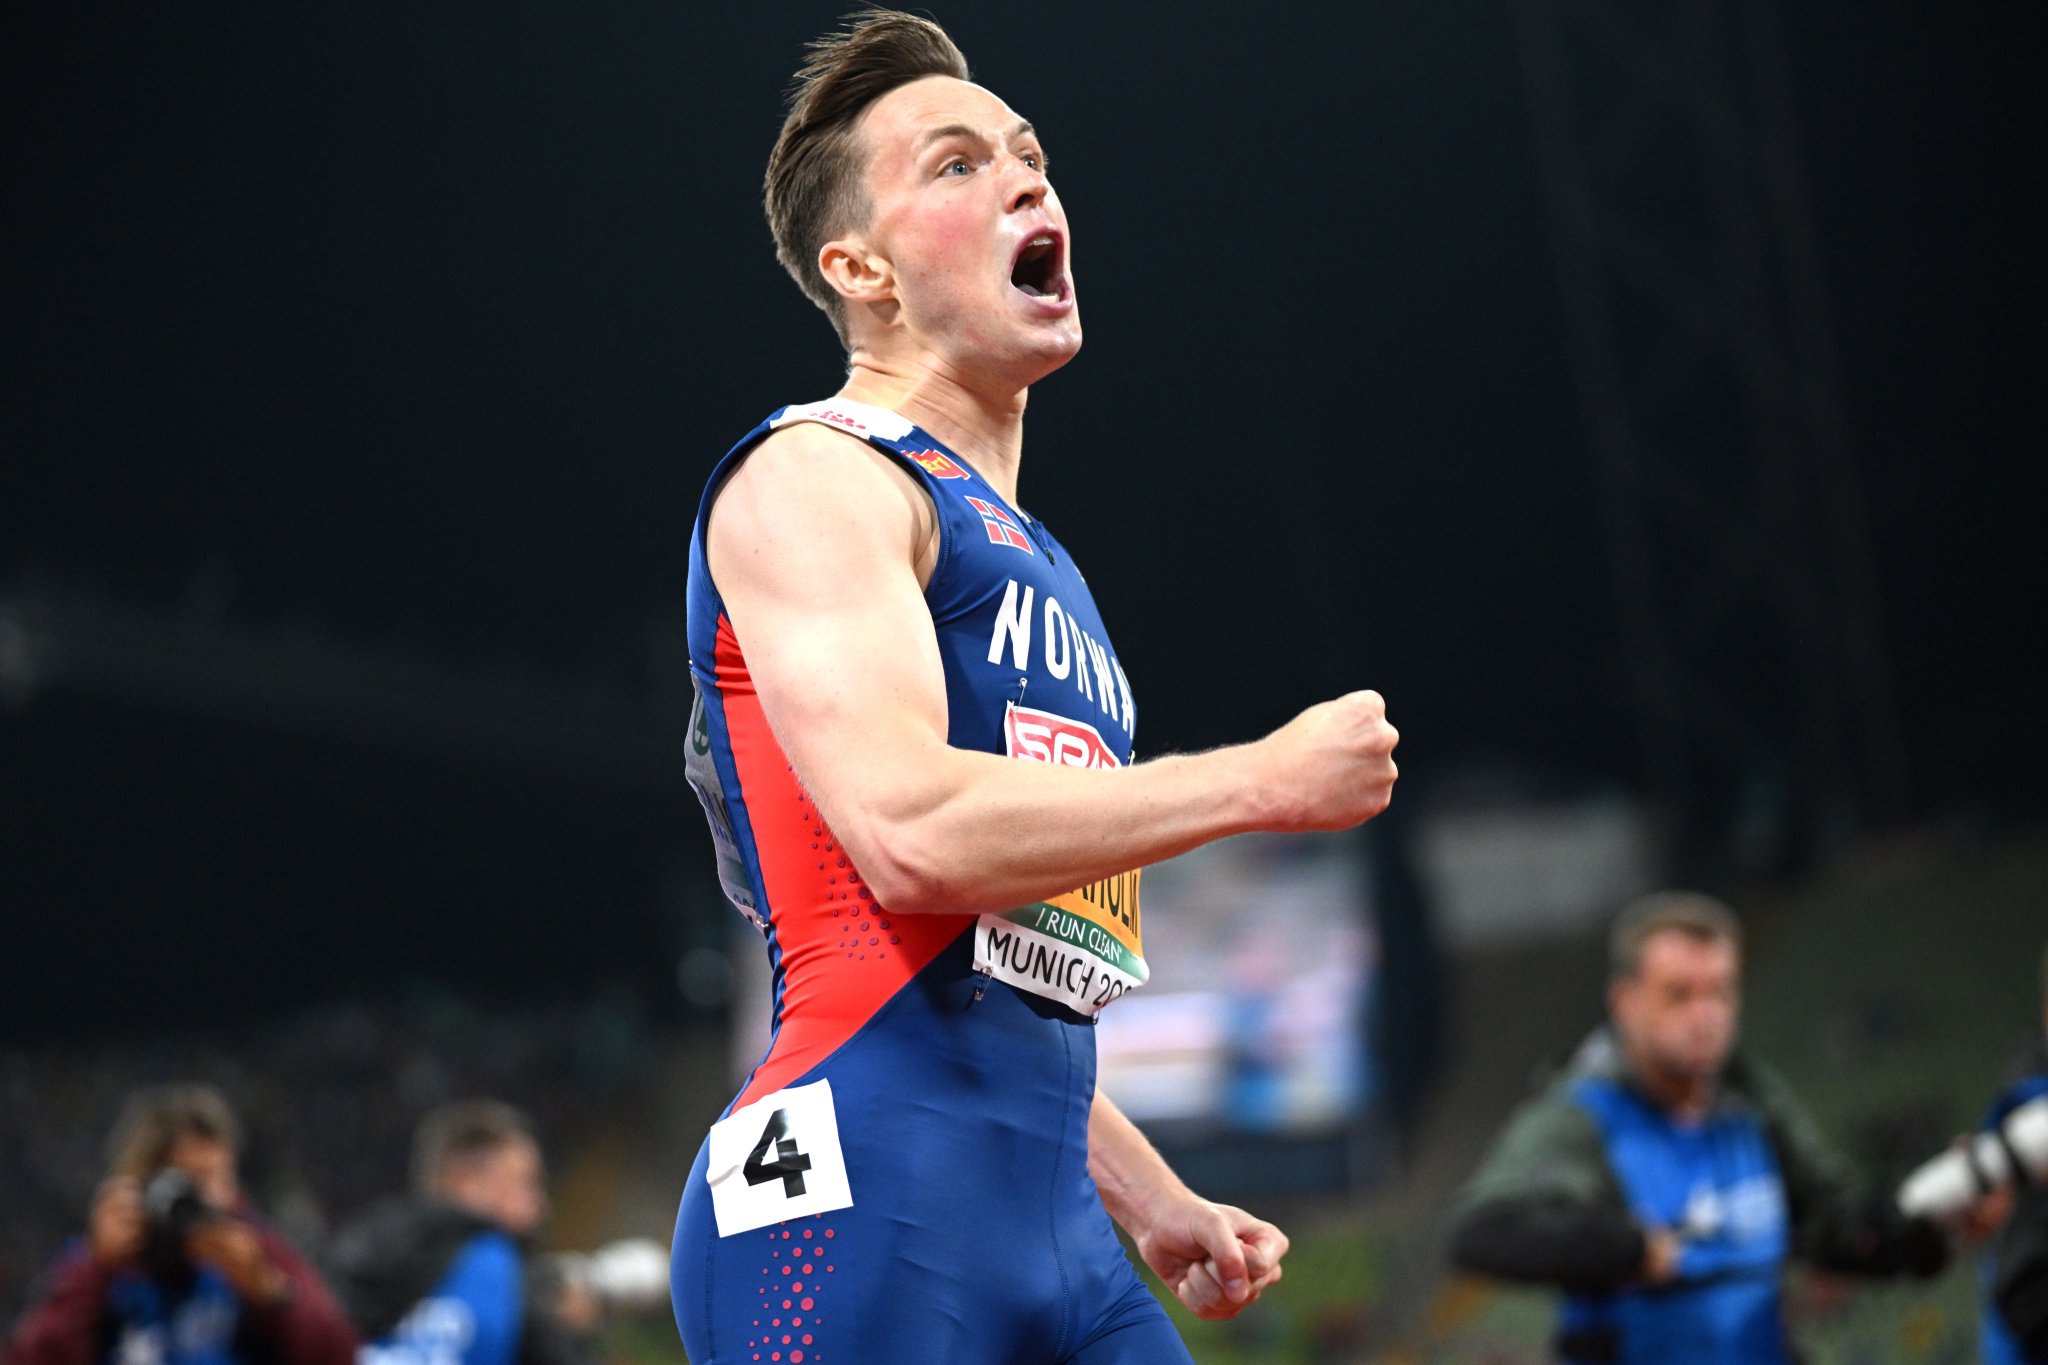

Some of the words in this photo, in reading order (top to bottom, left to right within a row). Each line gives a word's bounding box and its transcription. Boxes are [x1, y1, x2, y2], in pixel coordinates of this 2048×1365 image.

[987, 579, 1136, 740] NORWA
[987, 927, 1095, 1000] MUNICH
[1092, 973, 1132, 1007] 20
[1035, 907, 1046, 927] I
[1046, 911, 1086, 944] RUN
[742, 1108, 812, 1199] 4
